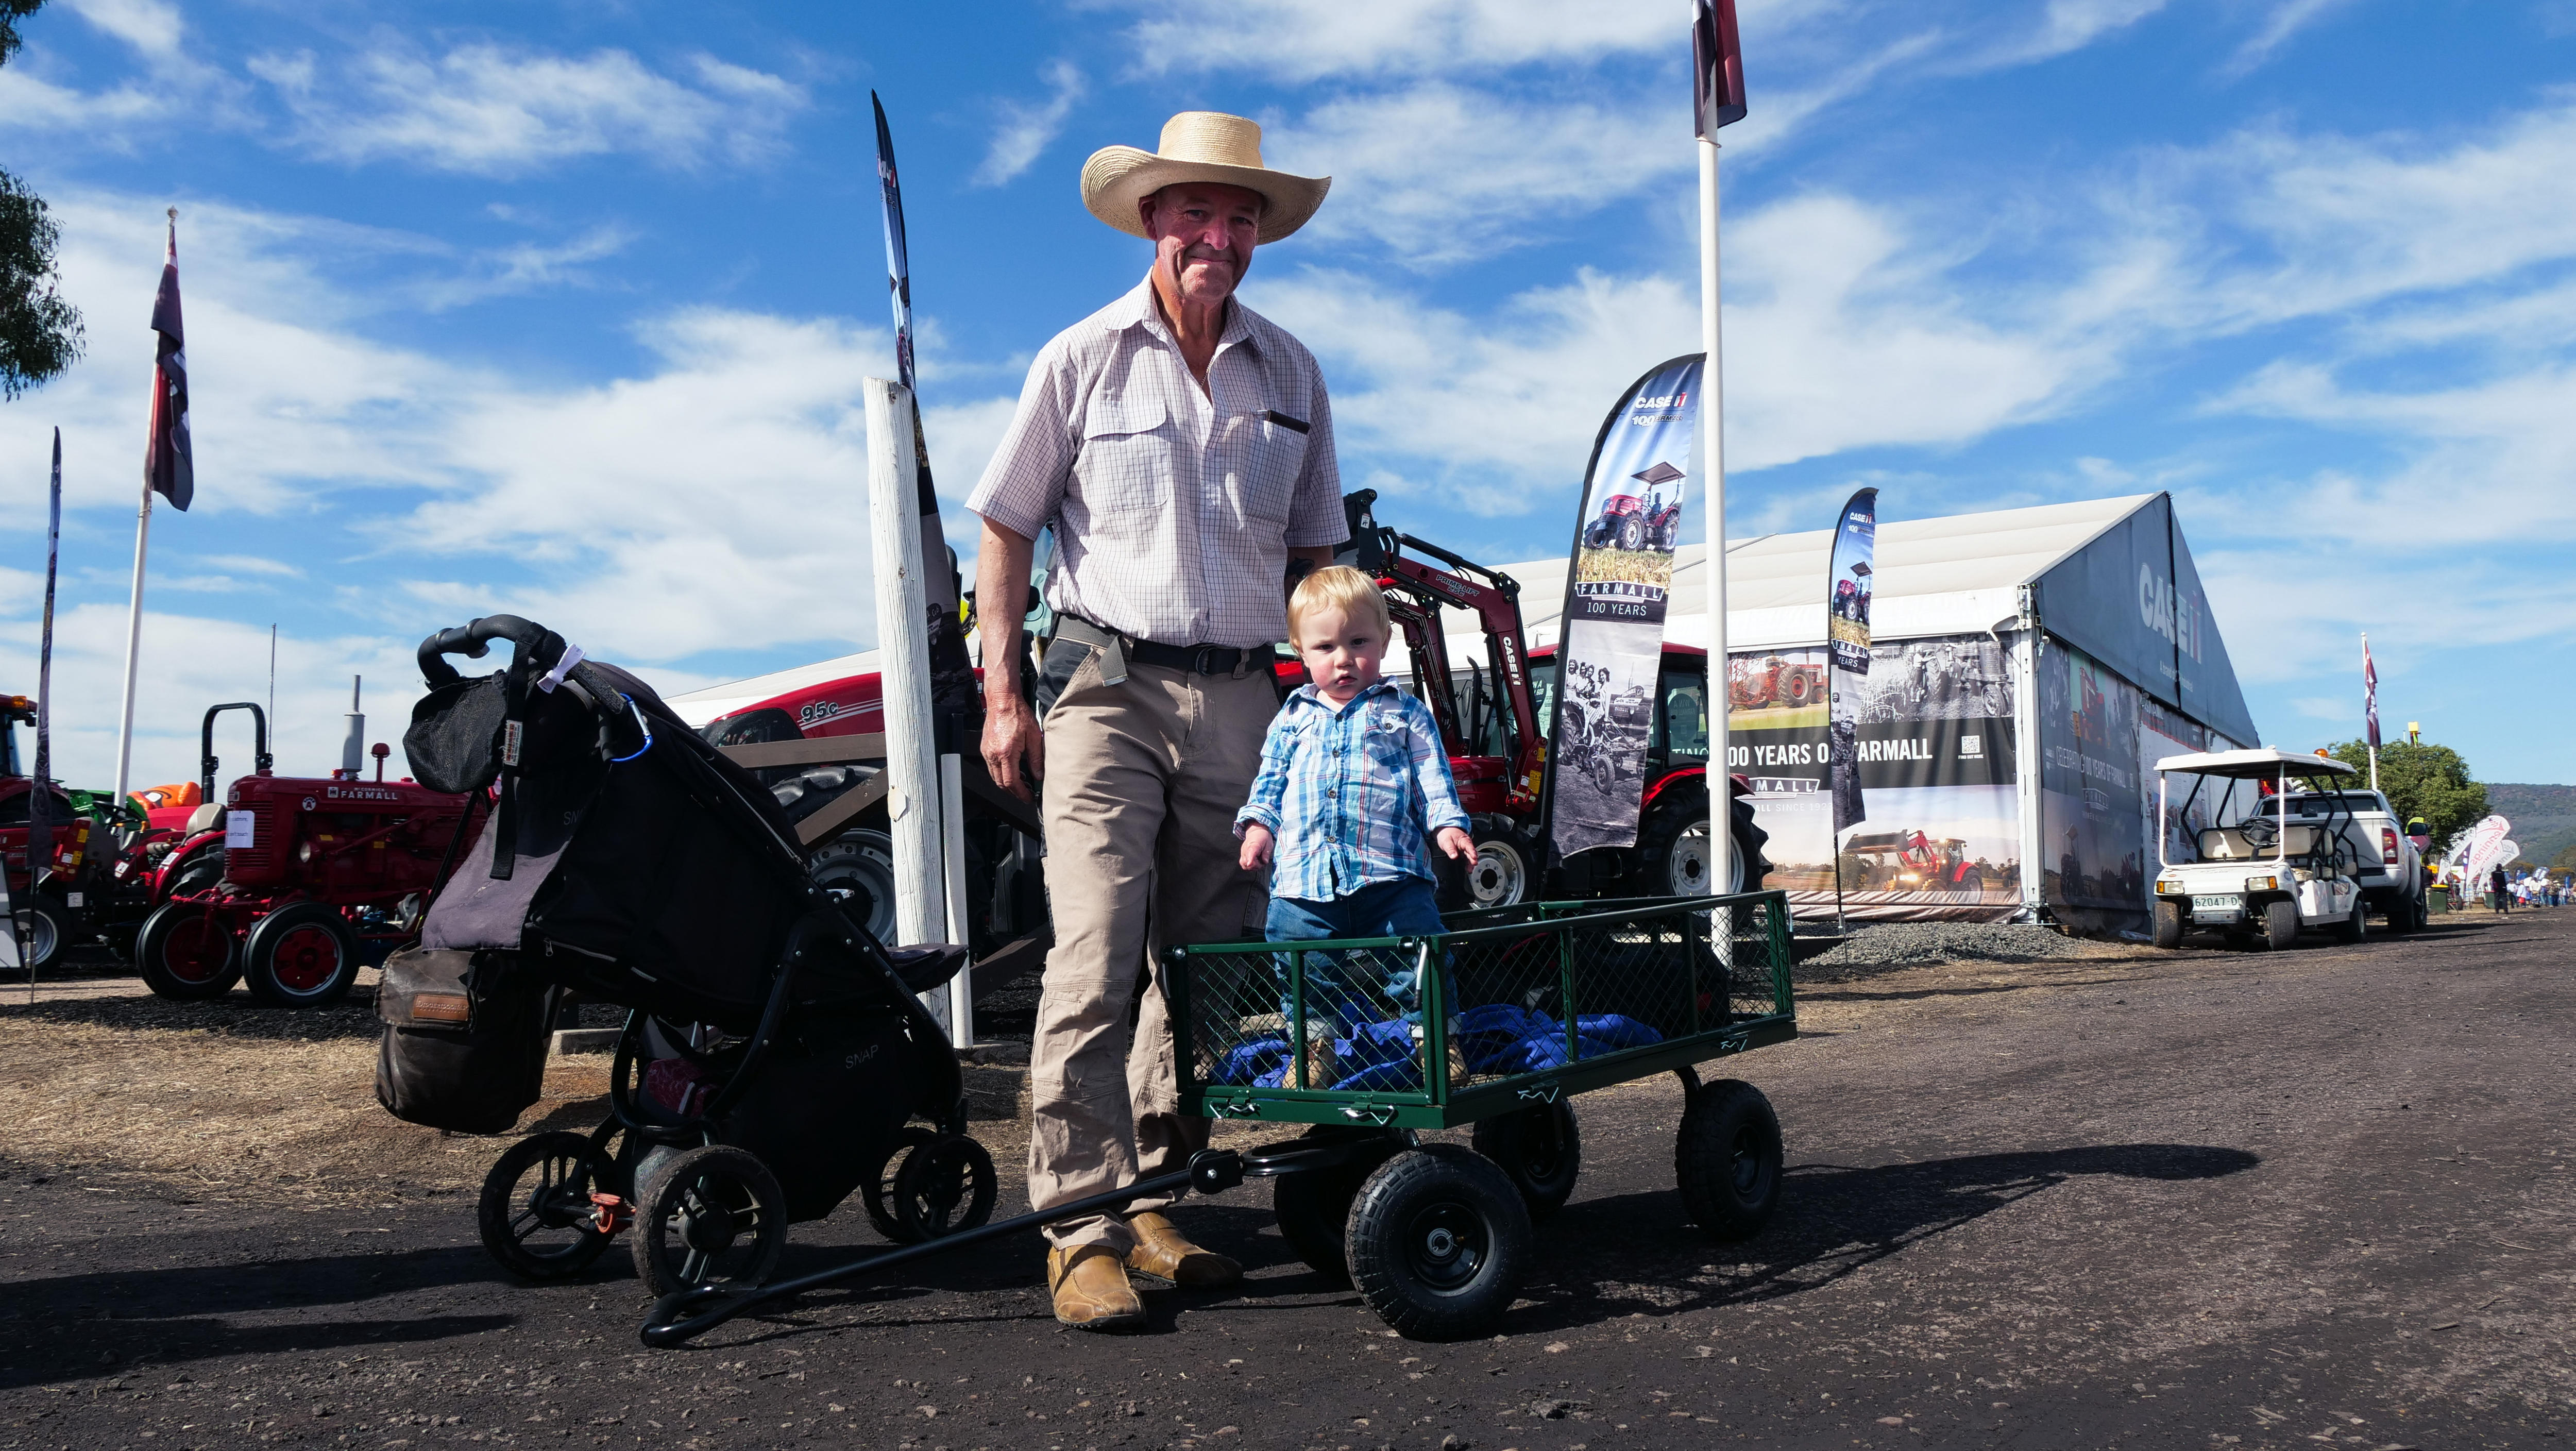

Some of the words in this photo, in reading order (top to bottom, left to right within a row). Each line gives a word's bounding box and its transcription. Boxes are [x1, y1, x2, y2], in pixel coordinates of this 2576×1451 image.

[1635, 395, 1673, 409] CASE
[1632, 415, 1655, 427] 100
[1850, 512, 1866, 523] CASE
[1848, 525, 1858, 533] 100
[1581, 583, 1658, 599] FARMALL
[1587, 602, 1606, 613] 100
[1612, 603, 1647, 616] YEARS
[2139, 563, 2188, 653] CASE
[1503, 636, 1518, 673] CASE
[1839, 642, 1866, 656] MALL
[1838, 655, 1858, 667] YEARS
[1728, 746, 1749, 767] 00
[1754, 743, 1811, 766] YEARS
[1817, 743, 1829, 764] O
[1854, 738, 1933, 762] ARMALL
[1756, 780, 1812, 792] MALL
[341, 791, 398, 800] FARMALL
[2195, 897, 2238, 907] 62047-D
[845, 1044, 878, 1069] SNAP
